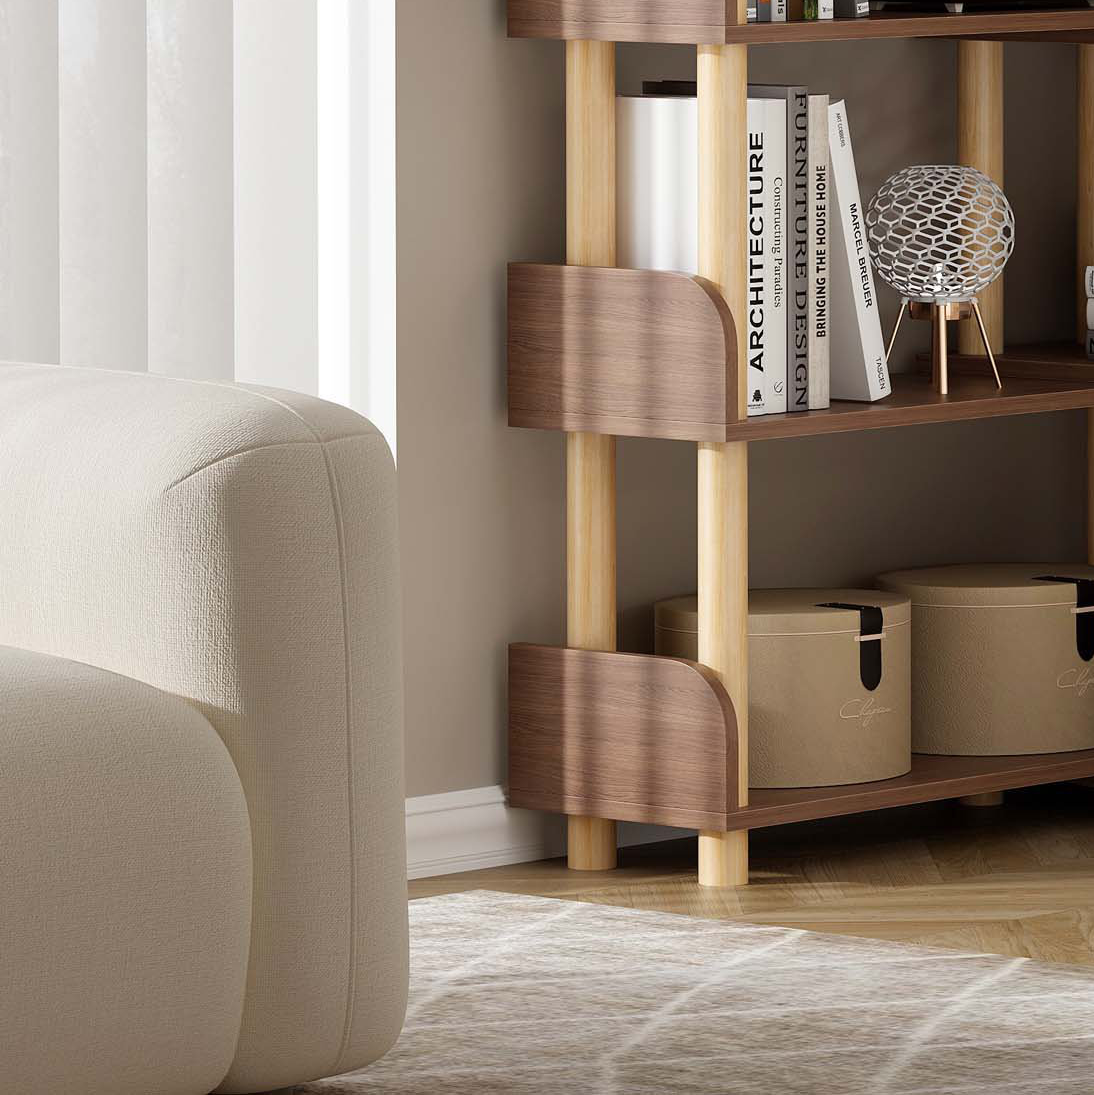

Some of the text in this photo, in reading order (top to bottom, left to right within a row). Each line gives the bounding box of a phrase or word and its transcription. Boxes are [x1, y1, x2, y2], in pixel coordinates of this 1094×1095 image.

[749, 132, 764, 372] ARCHITECTURE
[771, 177, 783, 308] Constructing Paradies
[794, 91, 808, 406] FURNITURE DESIGN
[816, 165, 827, 338] BRINGING THE HOUSE HOME
[849, 202, 873, 308] MARCEL BREUER
